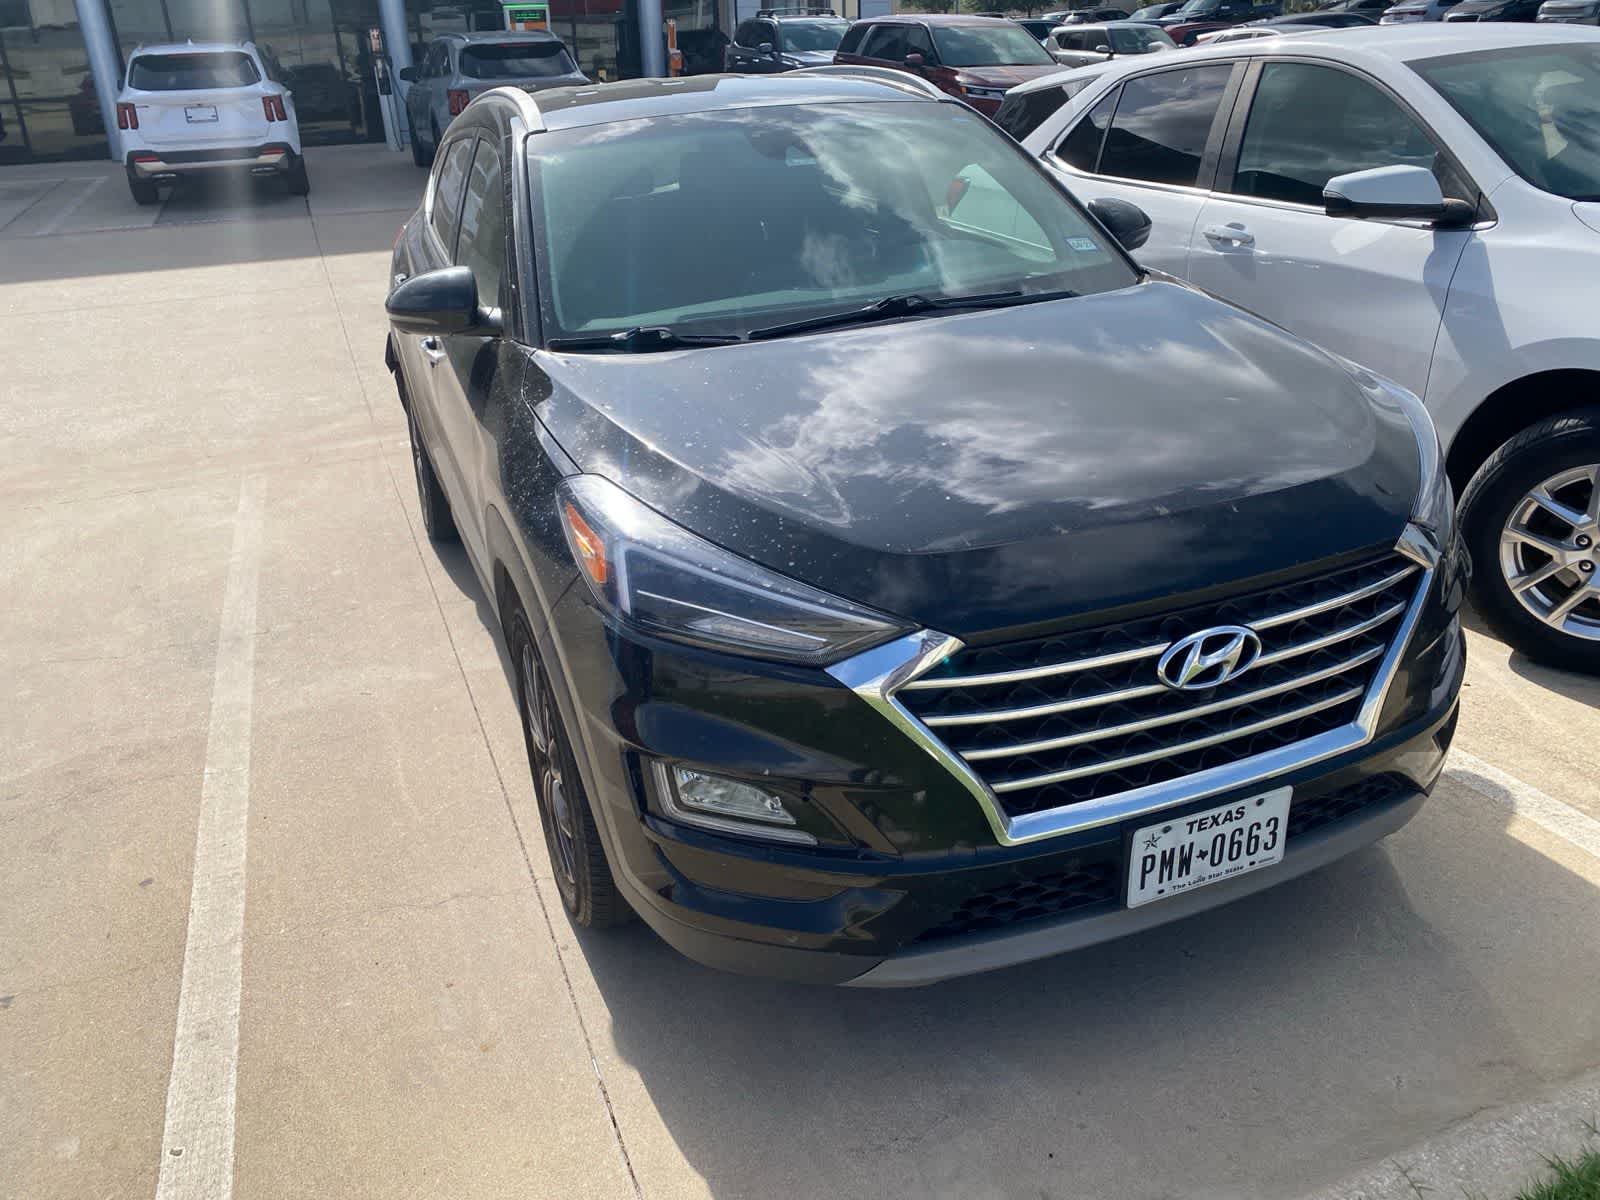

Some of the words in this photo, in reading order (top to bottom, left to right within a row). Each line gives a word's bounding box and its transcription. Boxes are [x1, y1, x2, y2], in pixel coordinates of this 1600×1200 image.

[1186, 806, 1246, 835] TEXAS
[1172, 883, 1186, 891] The
[1207, 871, 1223, 879] Star
[1224, 866, 1244, 874] State
